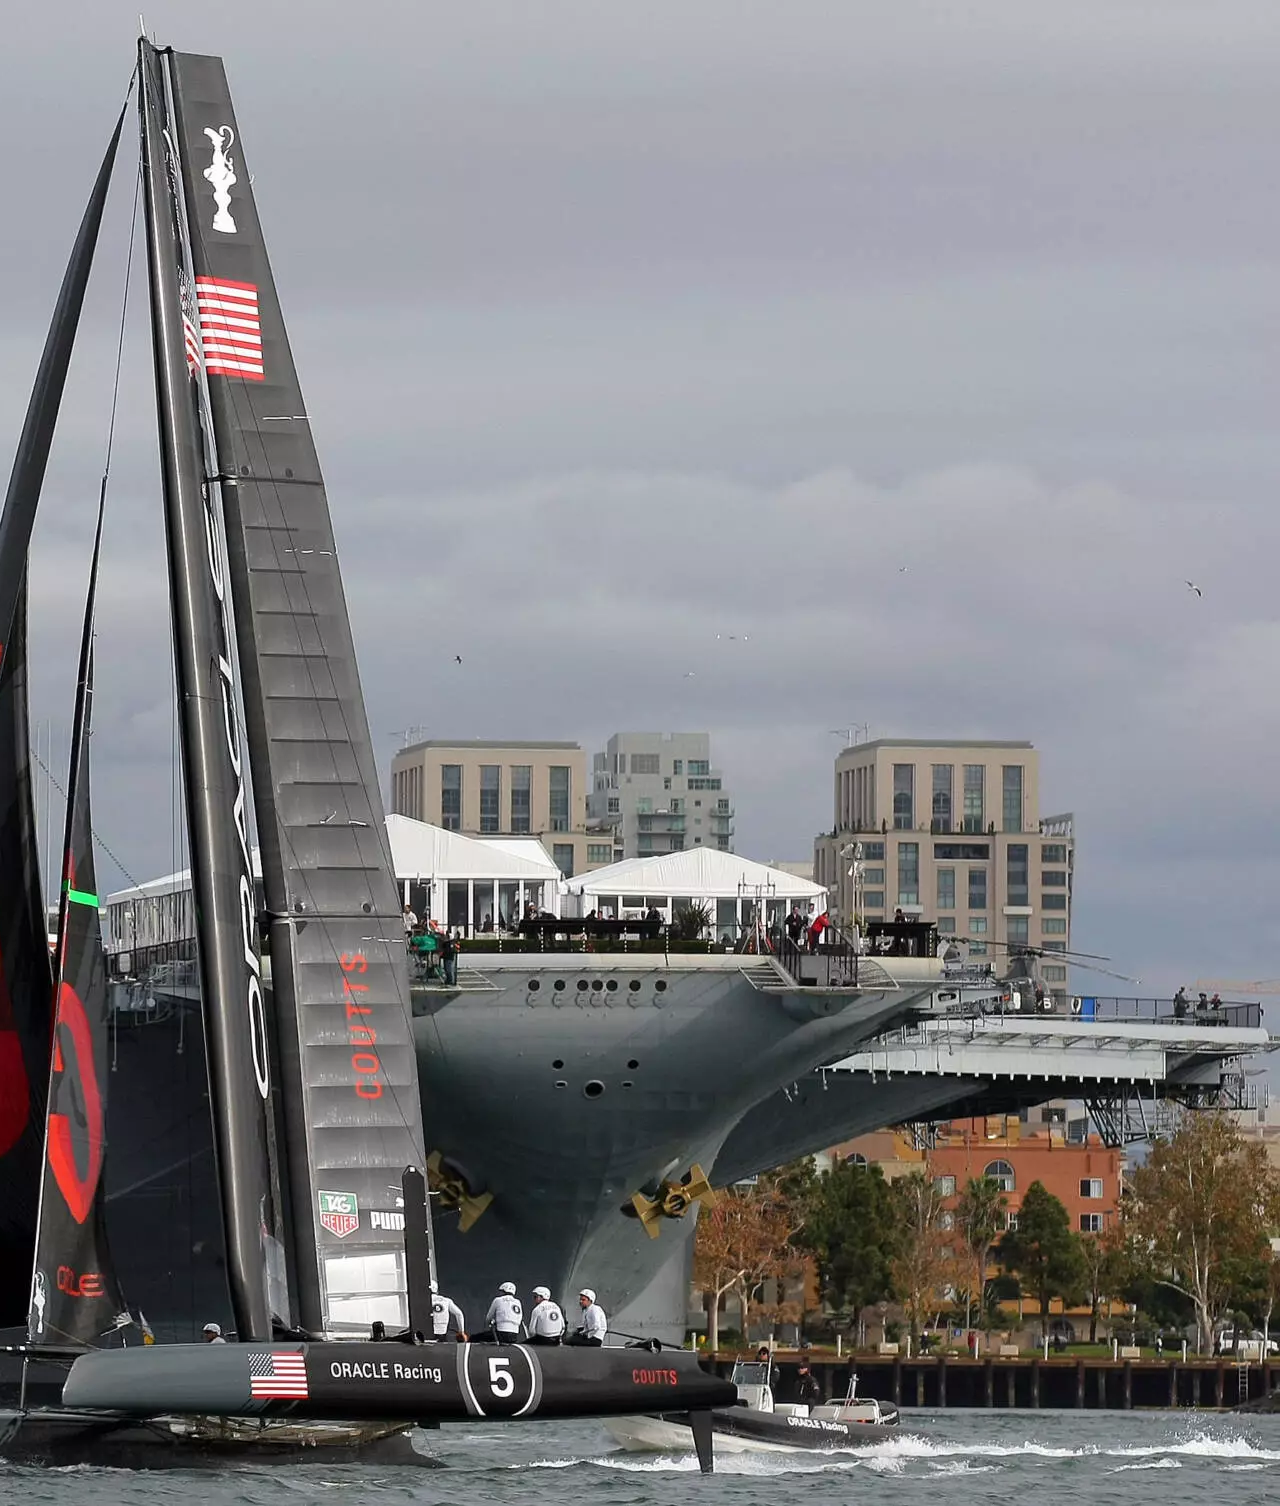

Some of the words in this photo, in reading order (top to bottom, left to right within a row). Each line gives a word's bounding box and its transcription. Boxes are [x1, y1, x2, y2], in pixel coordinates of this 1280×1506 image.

[340, 952, 383, 1100] COUTTS
[324, 1195, 352, 1213] TAG
[322, 1214, 356, 1235] HEUER
[370, 1211, 406, 1231] PUM
[329, 1362, 390, 1380] ORACLE
[394, 1363, 443, 1384] Racing
[488, 1357, 515, 1399] 5
[631, 1368, 678, 1386] COUTTS
[786, 1416, 821, 1430] ORACLE
[821, 1419, 849, 1434] Racing
